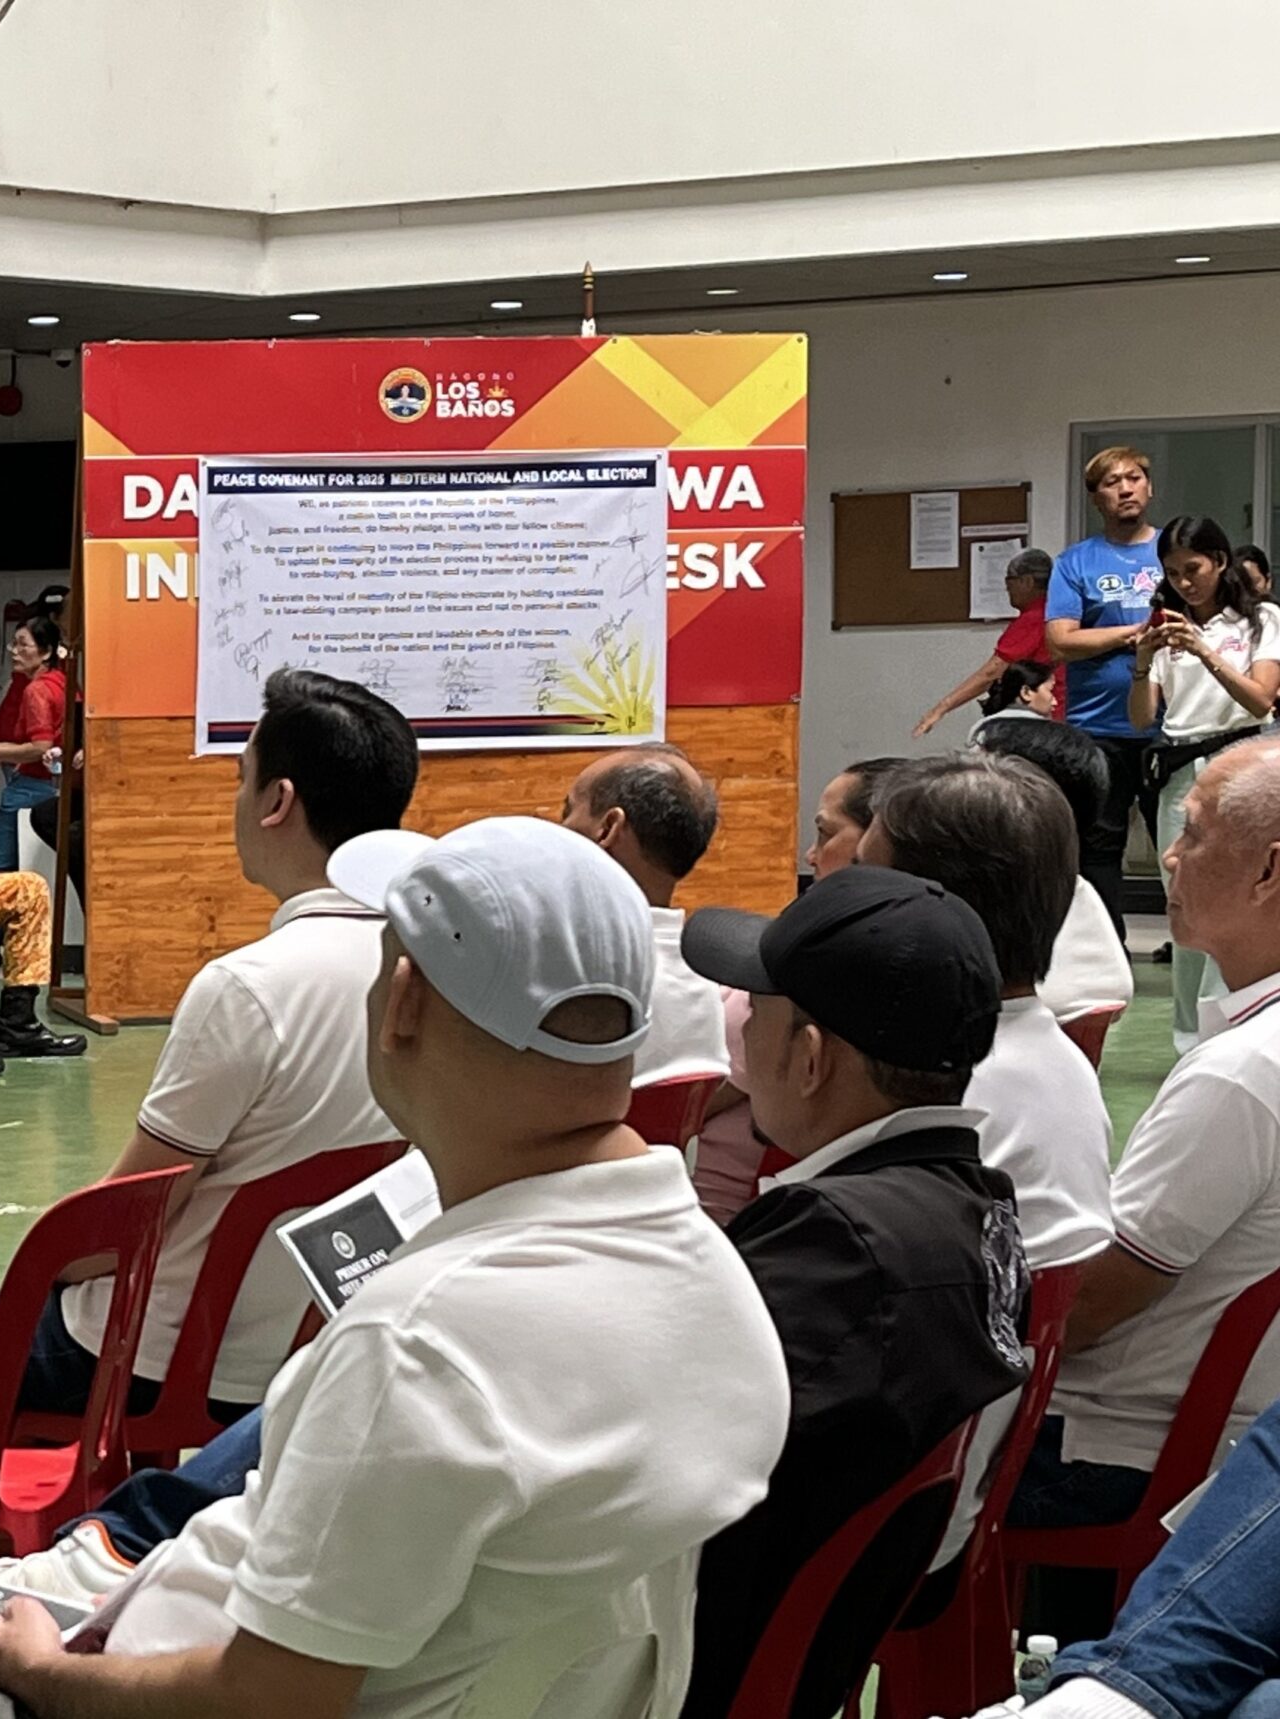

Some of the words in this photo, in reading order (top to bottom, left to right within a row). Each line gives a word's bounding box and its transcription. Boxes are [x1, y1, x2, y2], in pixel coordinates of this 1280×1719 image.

[436, 382, 480, 399] LOS
[436, 399, 516, 418] BAÑOS
[214, 474, 256, 487] PEACE
[258, 472, 325, 486] COVENANT
[328, 472, 354, 485] FOR
[358, 472, 384, 484] 2025
[391, 471, 446, 484] MIDTERM
[450, 470, 510, 483] NATIONAL
[513, 469, 540, 482] AND
[542, 468, 585, 481] LOCAL
[586, 467, 647, 481] ELECTION
[124, 473, 198, 519] DA
[126, 552, 198, 599] IN
[334, 1257, 372, 1282] PRIMER
[369, 1248, 389, 1266] ON
